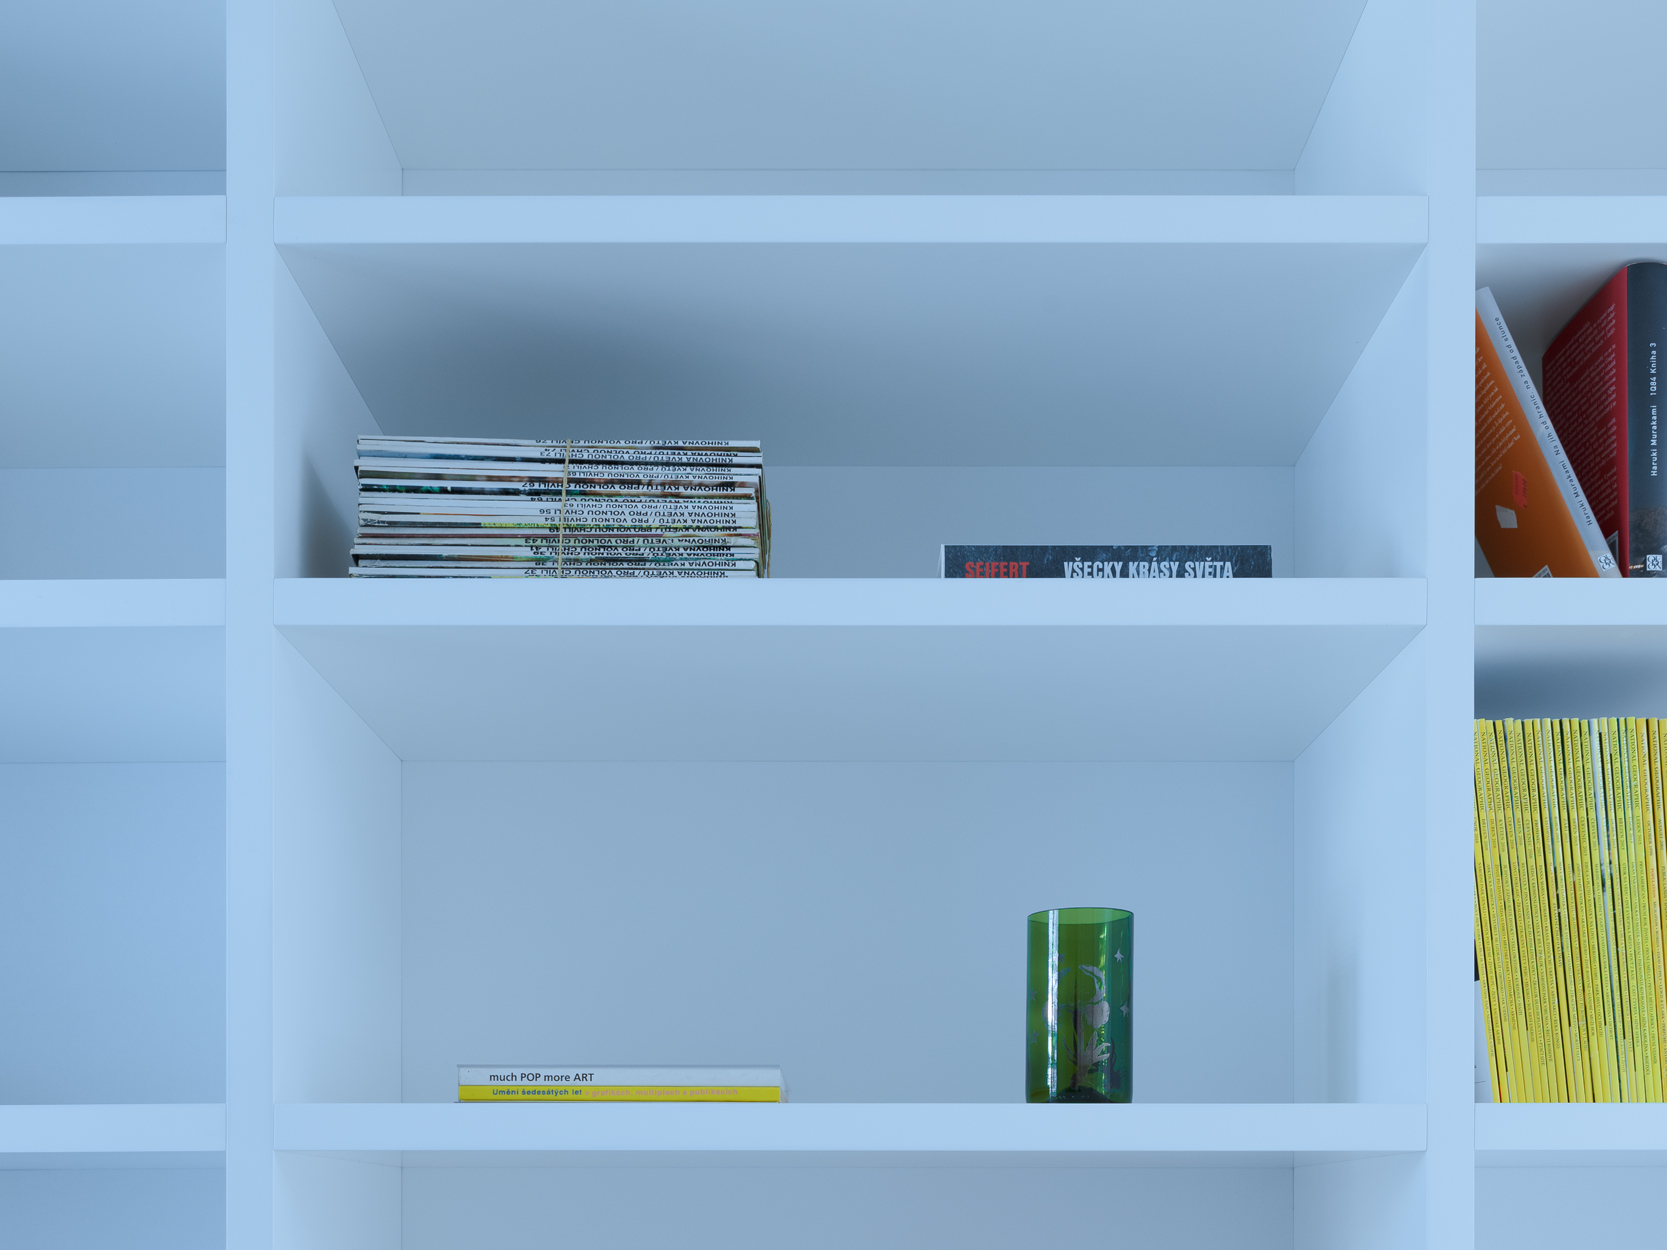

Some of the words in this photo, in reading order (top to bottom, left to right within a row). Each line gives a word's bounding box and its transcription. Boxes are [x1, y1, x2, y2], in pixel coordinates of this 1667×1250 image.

[1495, 317, 1508, 342] slunce
[1506, 344, 1514, 353] od
[1511, 356, 1525, 378] západ
[1649, 351, 1657, 374] Kniha
[1524, 380, 1530, 390] na
[1541, 422, 1550, 430] od
[1650, 405, 1658, 446] Murakami
[1547, 433, 1556, 443] jih
[1553, 445, 1561, 456] Na
[1650, 449, 1658, 476] Haruki
[1558, 460, 1580, 498] Murakami
[1577, 501, 1593, 526] Haruki
[965, 561, 1029, 578] SEIFERT
[1064, 557, 1123, 578] VŠECKY
[1129, 557, 1180, 578] KRÁSY
[1184, 557, 1233, 578] SVĚTA
[490, 1073, 517, 1082] much
[520, 1073, 541, 1082] POP
[544, 1074, 570, 1082] more
[573, 1073, 594, 1082] ART
[522, 1089, 569, 1097] šedesátých
